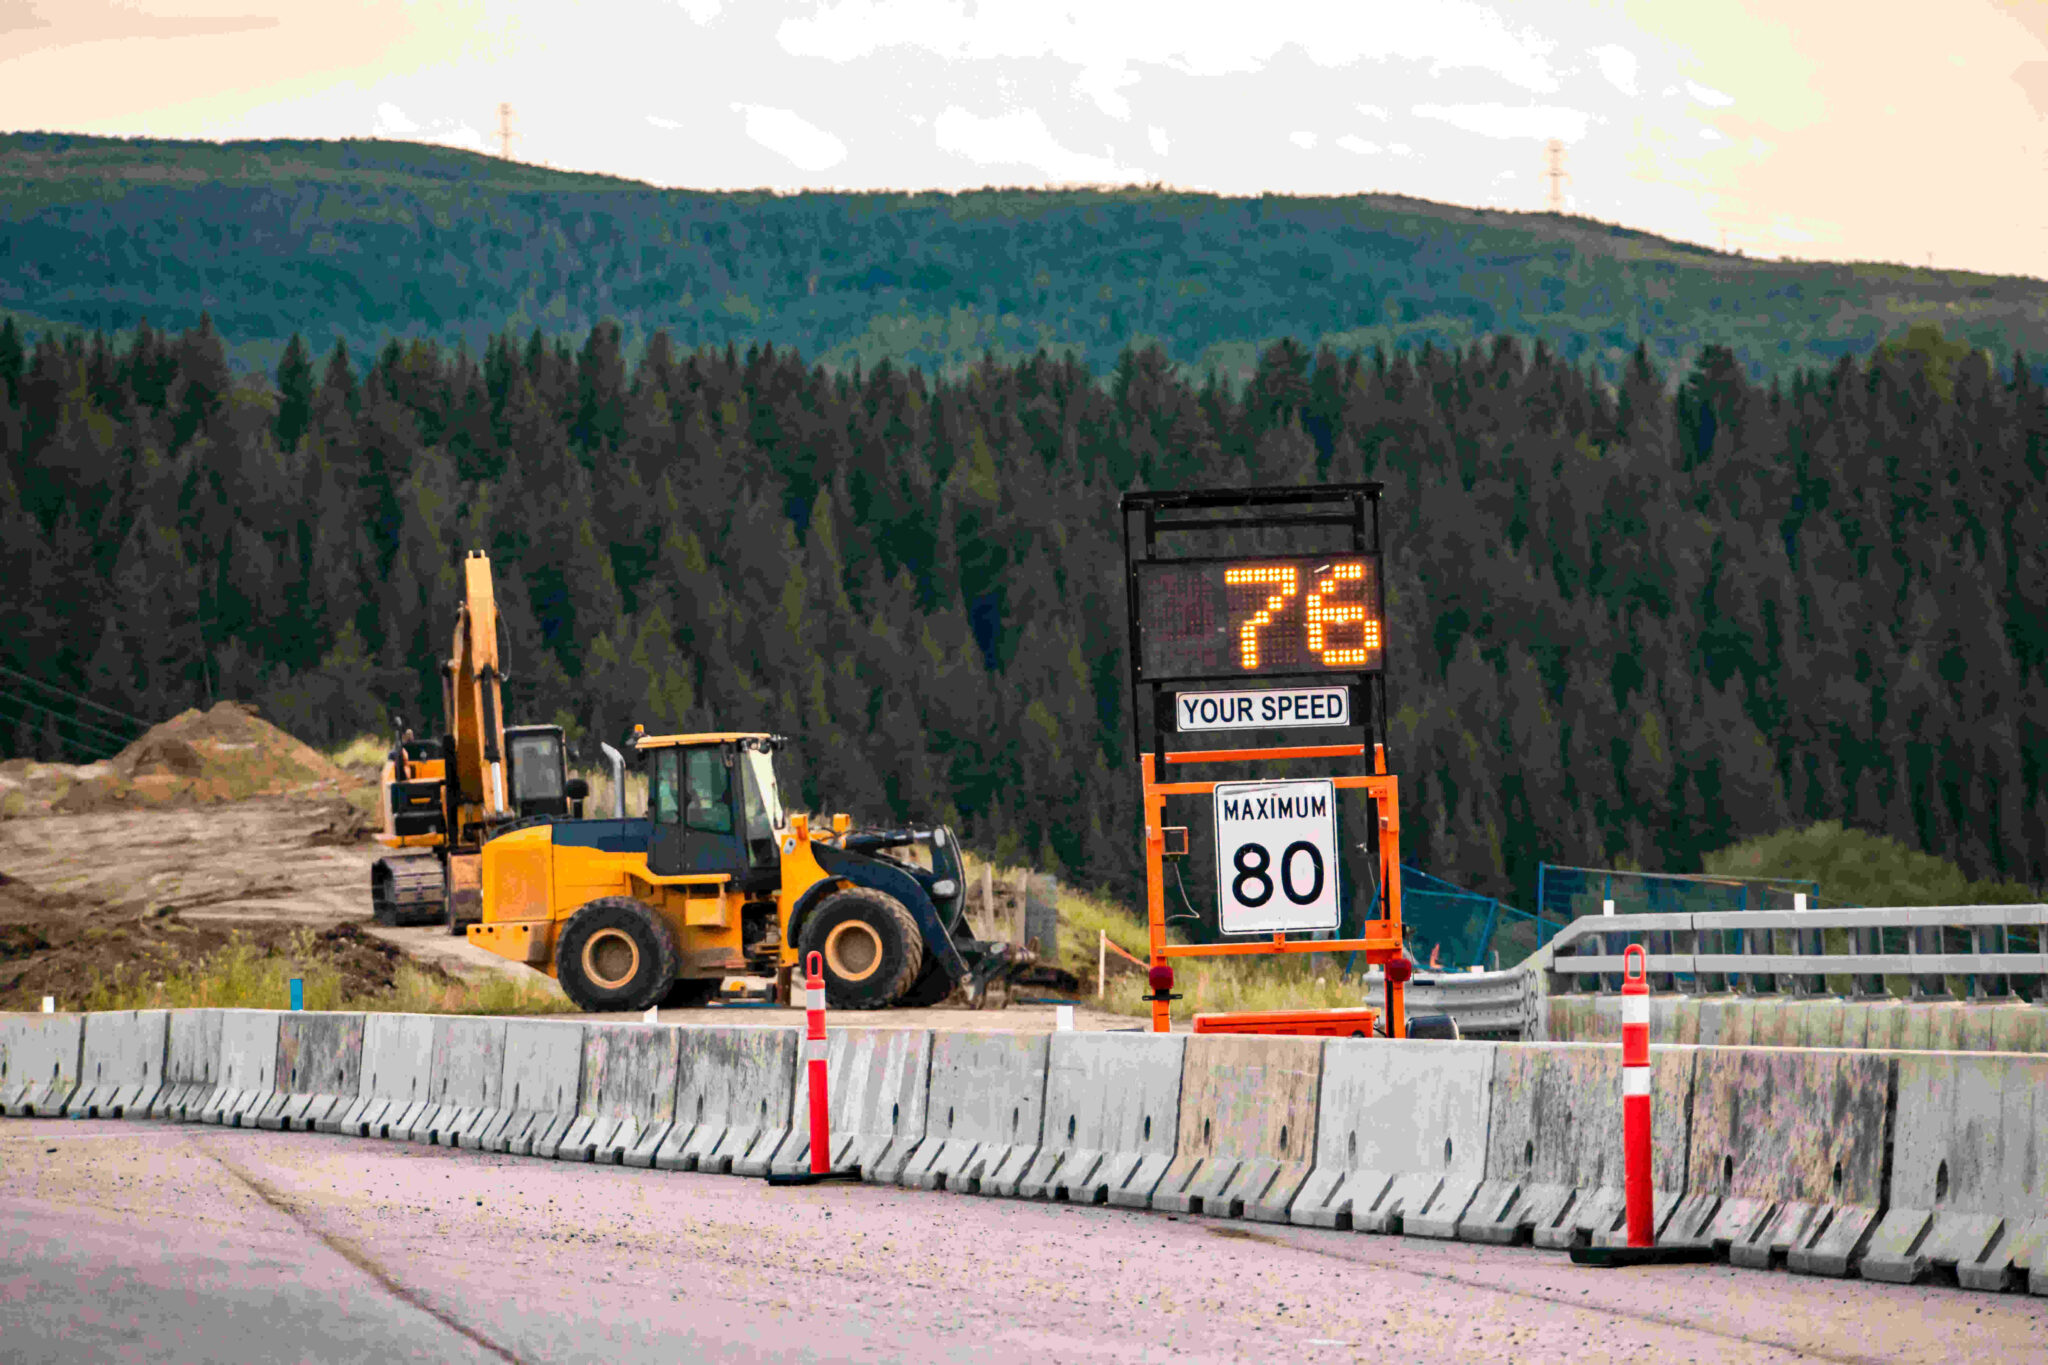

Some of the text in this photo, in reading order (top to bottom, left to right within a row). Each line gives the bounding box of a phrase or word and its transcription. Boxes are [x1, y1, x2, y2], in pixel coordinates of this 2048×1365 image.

[1225, 564, 1380, 669] 76
[1183, 693, 1343, 724] YOUR SPEED
[1223, 796, 1327, 821] MAXIMUM
[1231, 840, 1325, 908] 80
